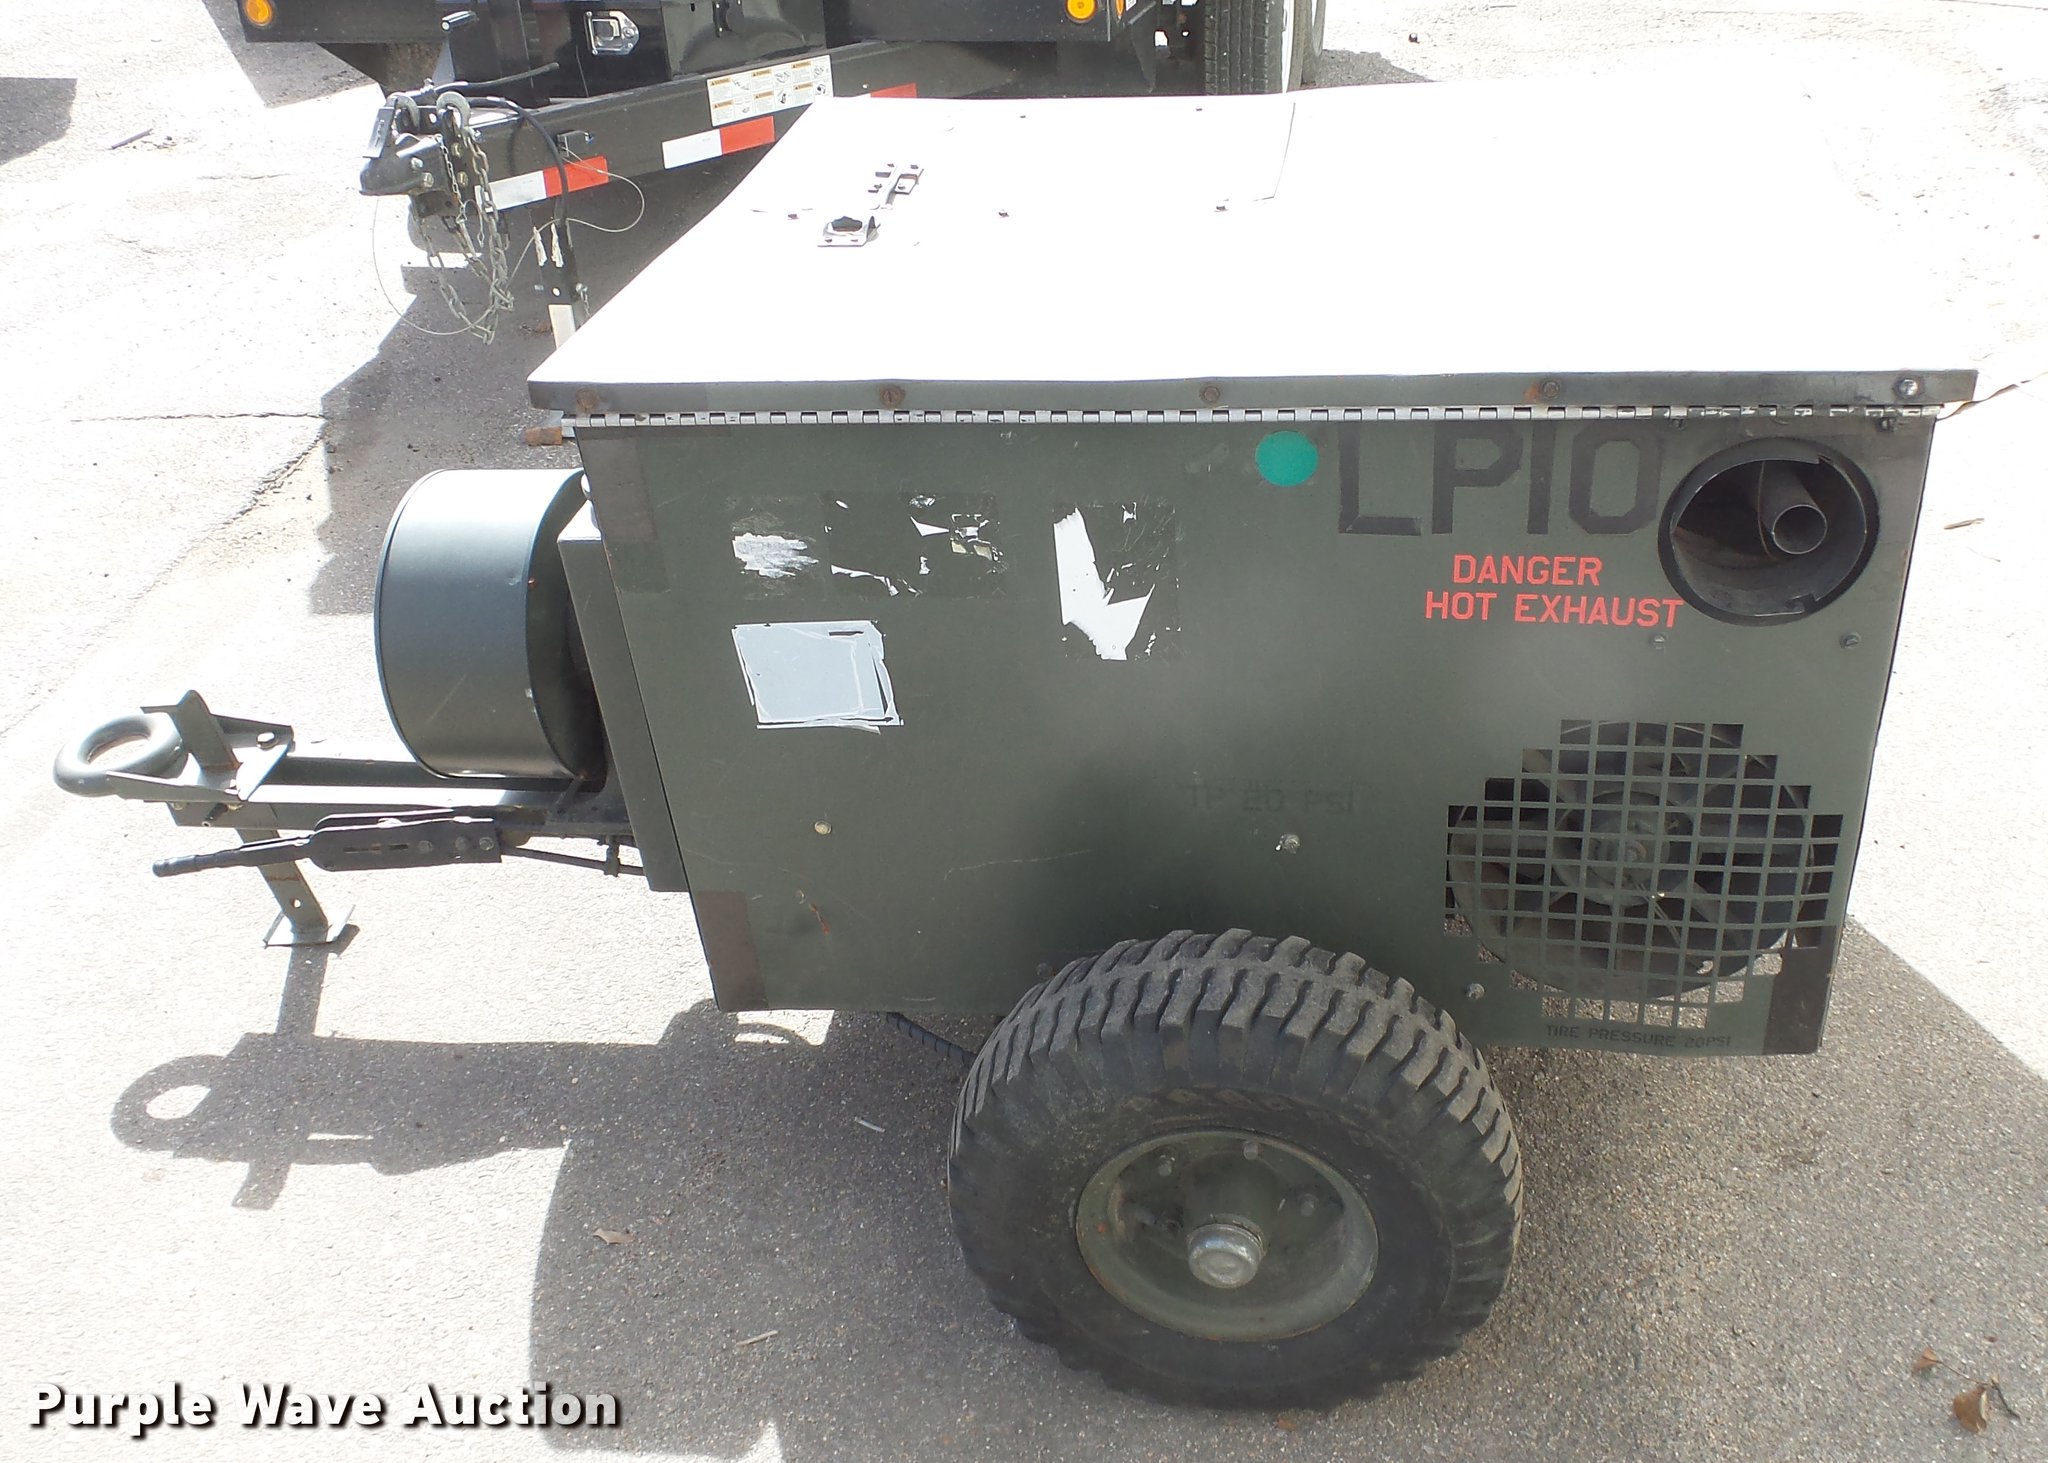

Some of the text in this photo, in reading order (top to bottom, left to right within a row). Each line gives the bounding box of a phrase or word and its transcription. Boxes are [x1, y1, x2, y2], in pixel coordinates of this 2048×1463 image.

[1452, 553, 1603, 586] DANGER
[1424, 590, 1685, 628] HOT EXHAUST
[1242, 787, 1286, 813] 20
[1304, 788, 1355, 816] PSI
[1545, 1023, 1581, 1040] TIRE
[1587, 1026, 1677, 1048] PRESSURE
